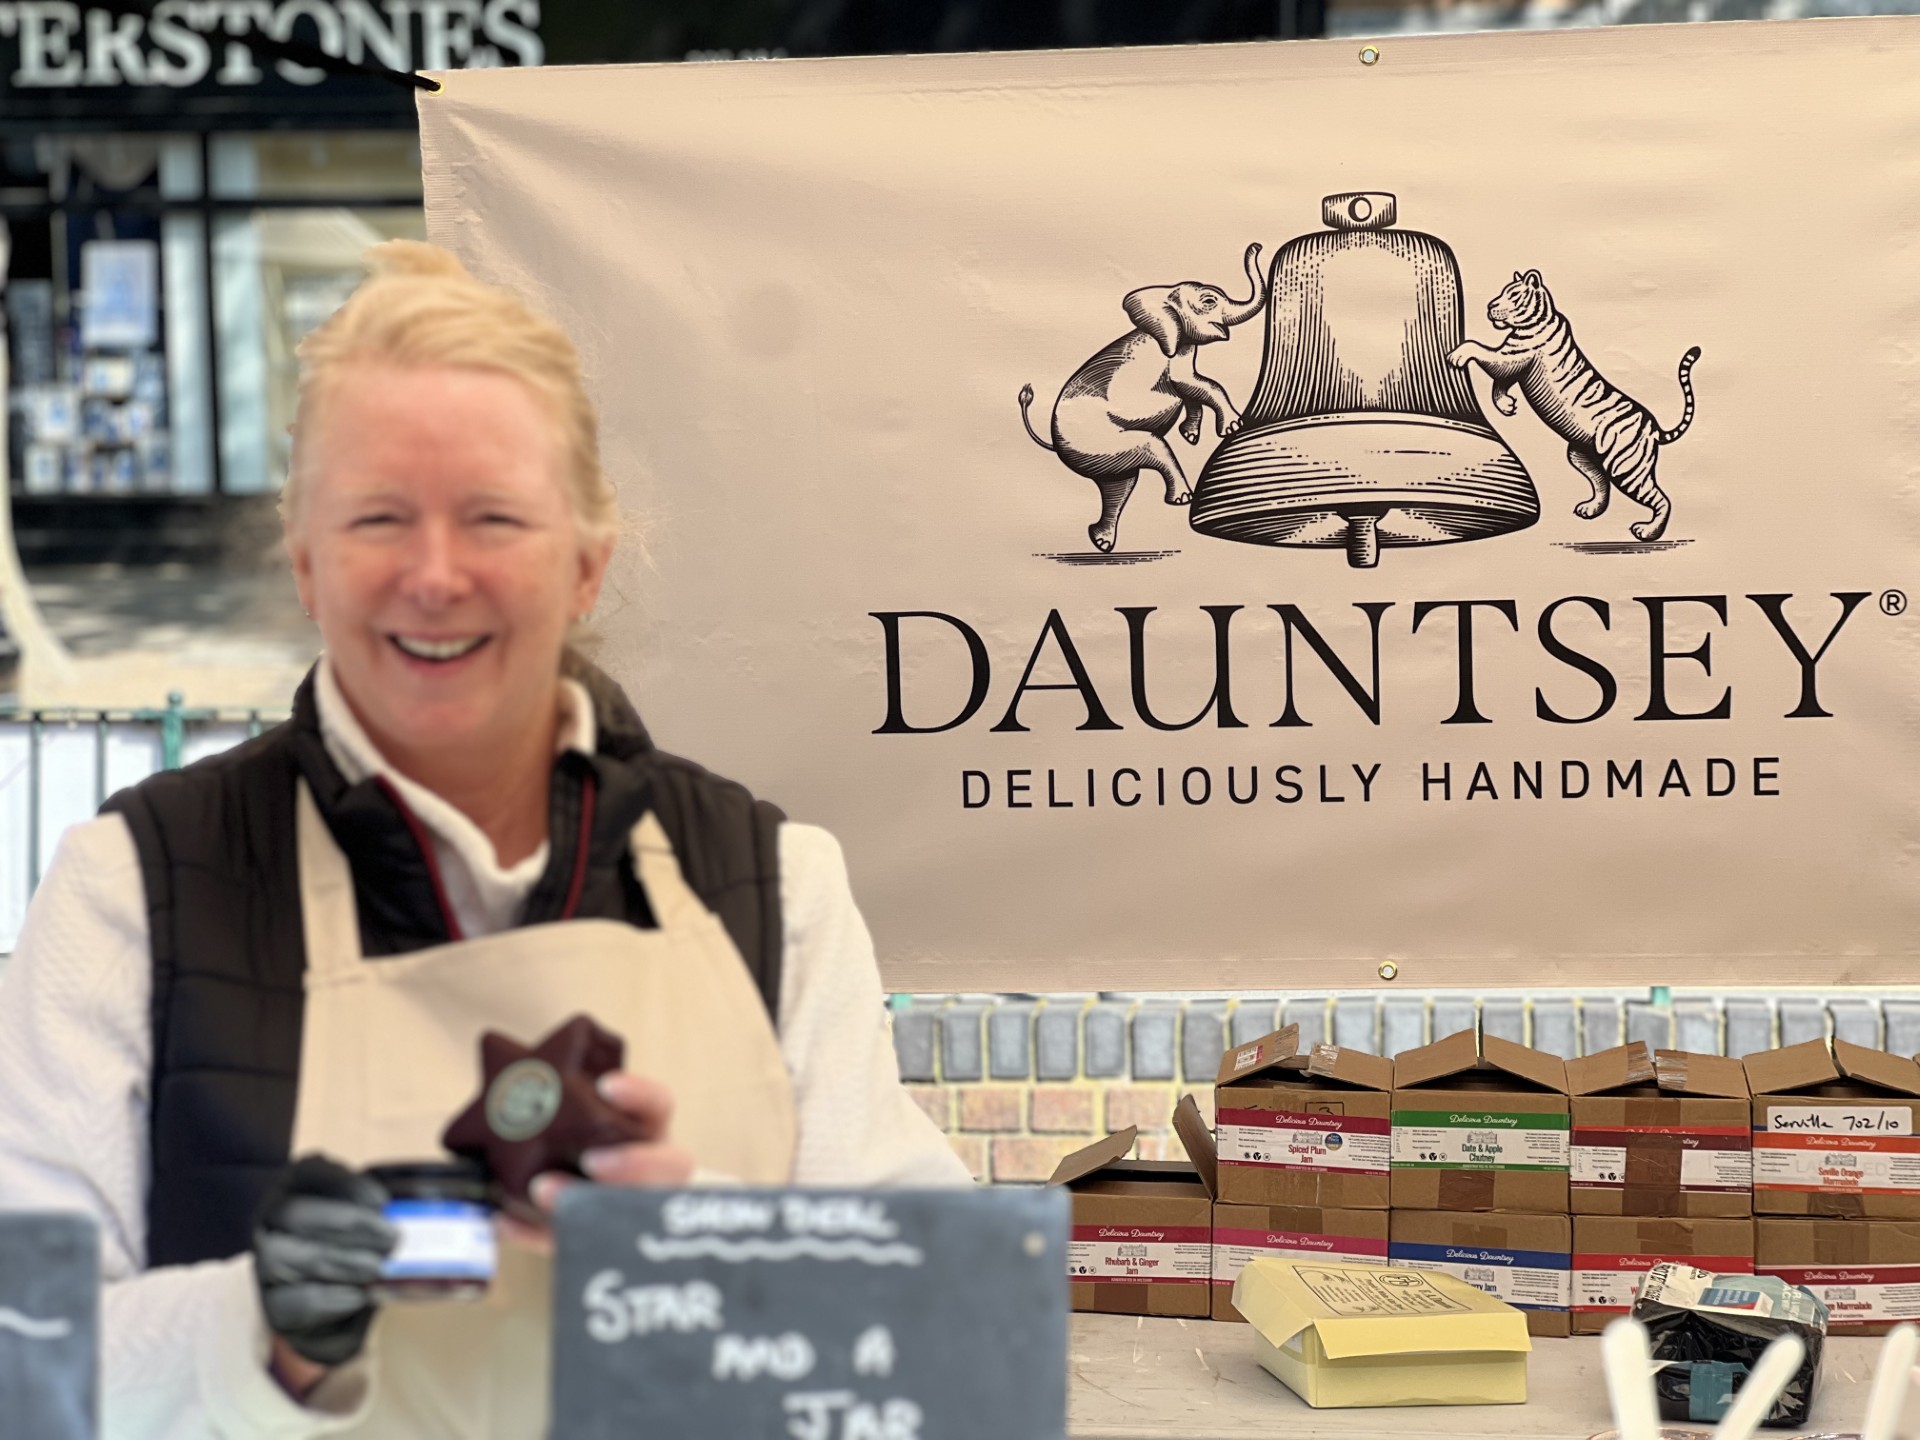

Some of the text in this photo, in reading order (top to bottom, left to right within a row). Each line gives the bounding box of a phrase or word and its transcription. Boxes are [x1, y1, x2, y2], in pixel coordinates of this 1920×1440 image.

[0, 0, 545, 87] ERSTONES
[963, 758, 1779, 808] DELICIOUSLY HANDMADE
[1842, 1110, 1900, 1131] 702/10
[1288, 1144, 1327, 1155] Spiced Plum
[1461, 1143, 1503, 1154] Date & Apple
[1300, 1155, 1314, 1164] Jam
[1469, 1153, 1496, 1164] Chutney
[1841, 1168, 1864, 1180] Orange
[1104, 1257, 1160, 1269] Rhubarb & Ginger
[1125, 1267, 1139, 1275] Jam
[1484, 1282, 1497, 1292] Jam
